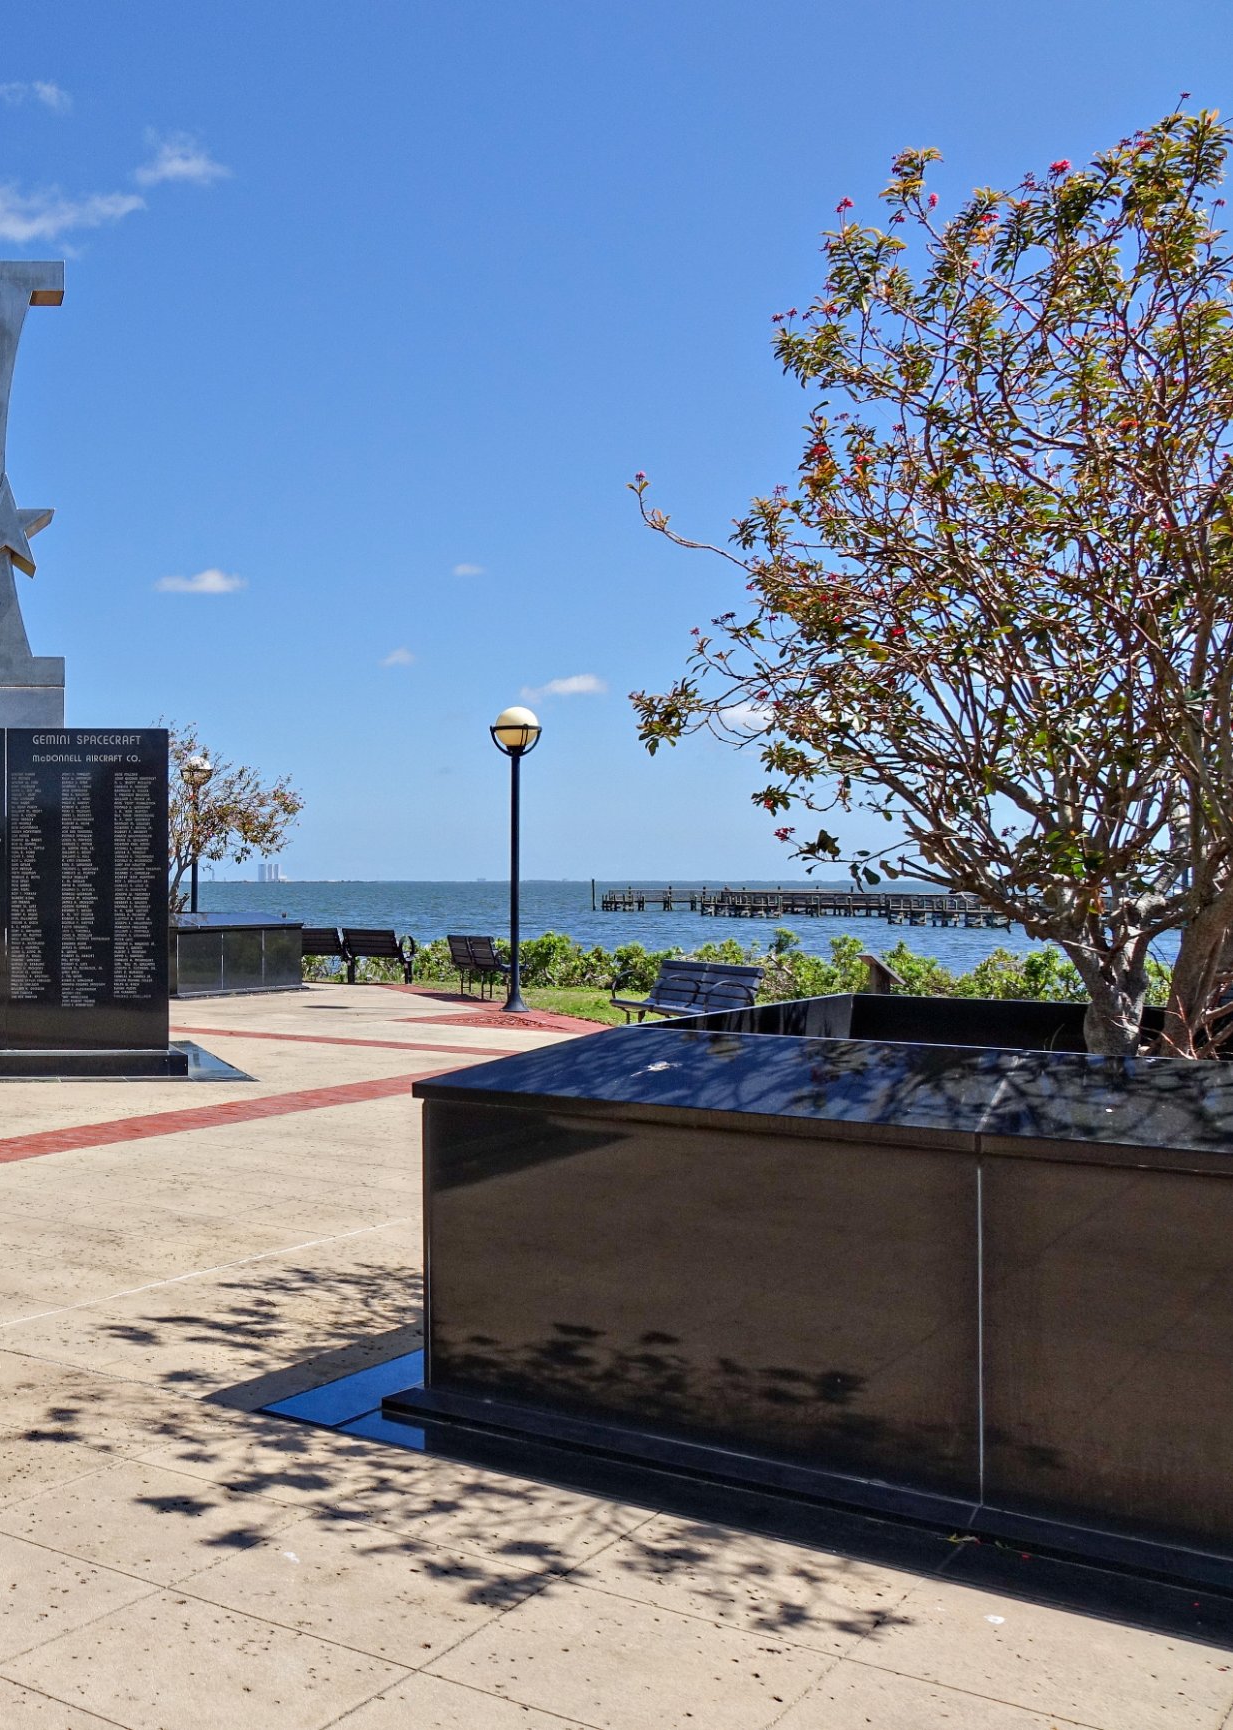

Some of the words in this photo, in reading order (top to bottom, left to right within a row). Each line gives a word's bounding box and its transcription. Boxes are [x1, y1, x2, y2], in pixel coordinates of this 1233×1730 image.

[32, 734, 70, 745] GEMINI
[76, 734, 142, 745] SPACECRAFT
[85, 754, 123, 763] AIRCRAFT
[126, 754, 142, 763] CO.
